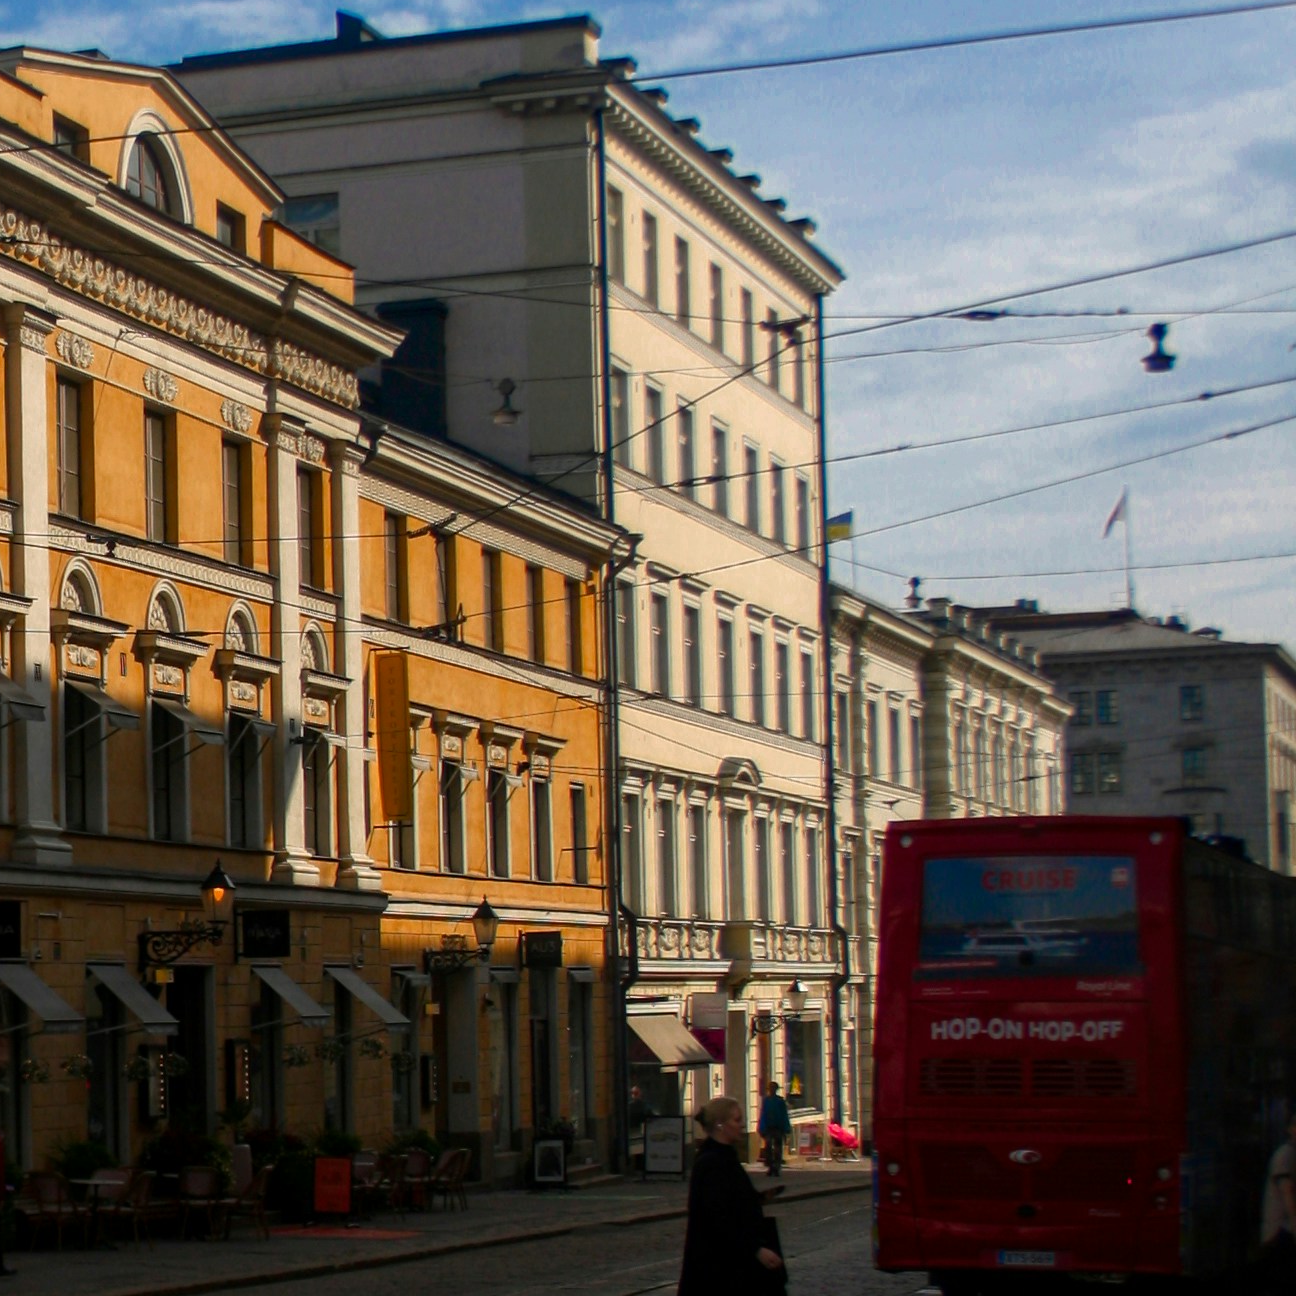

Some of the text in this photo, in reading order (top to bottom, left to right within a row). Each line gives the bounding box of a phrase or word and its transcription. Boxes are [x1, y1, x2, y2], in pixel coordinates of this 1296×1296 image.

[981, 869, 1077, 891] CRUISE
[930, 1017, 1124, 1042] HOP-ON HOP-OFF
